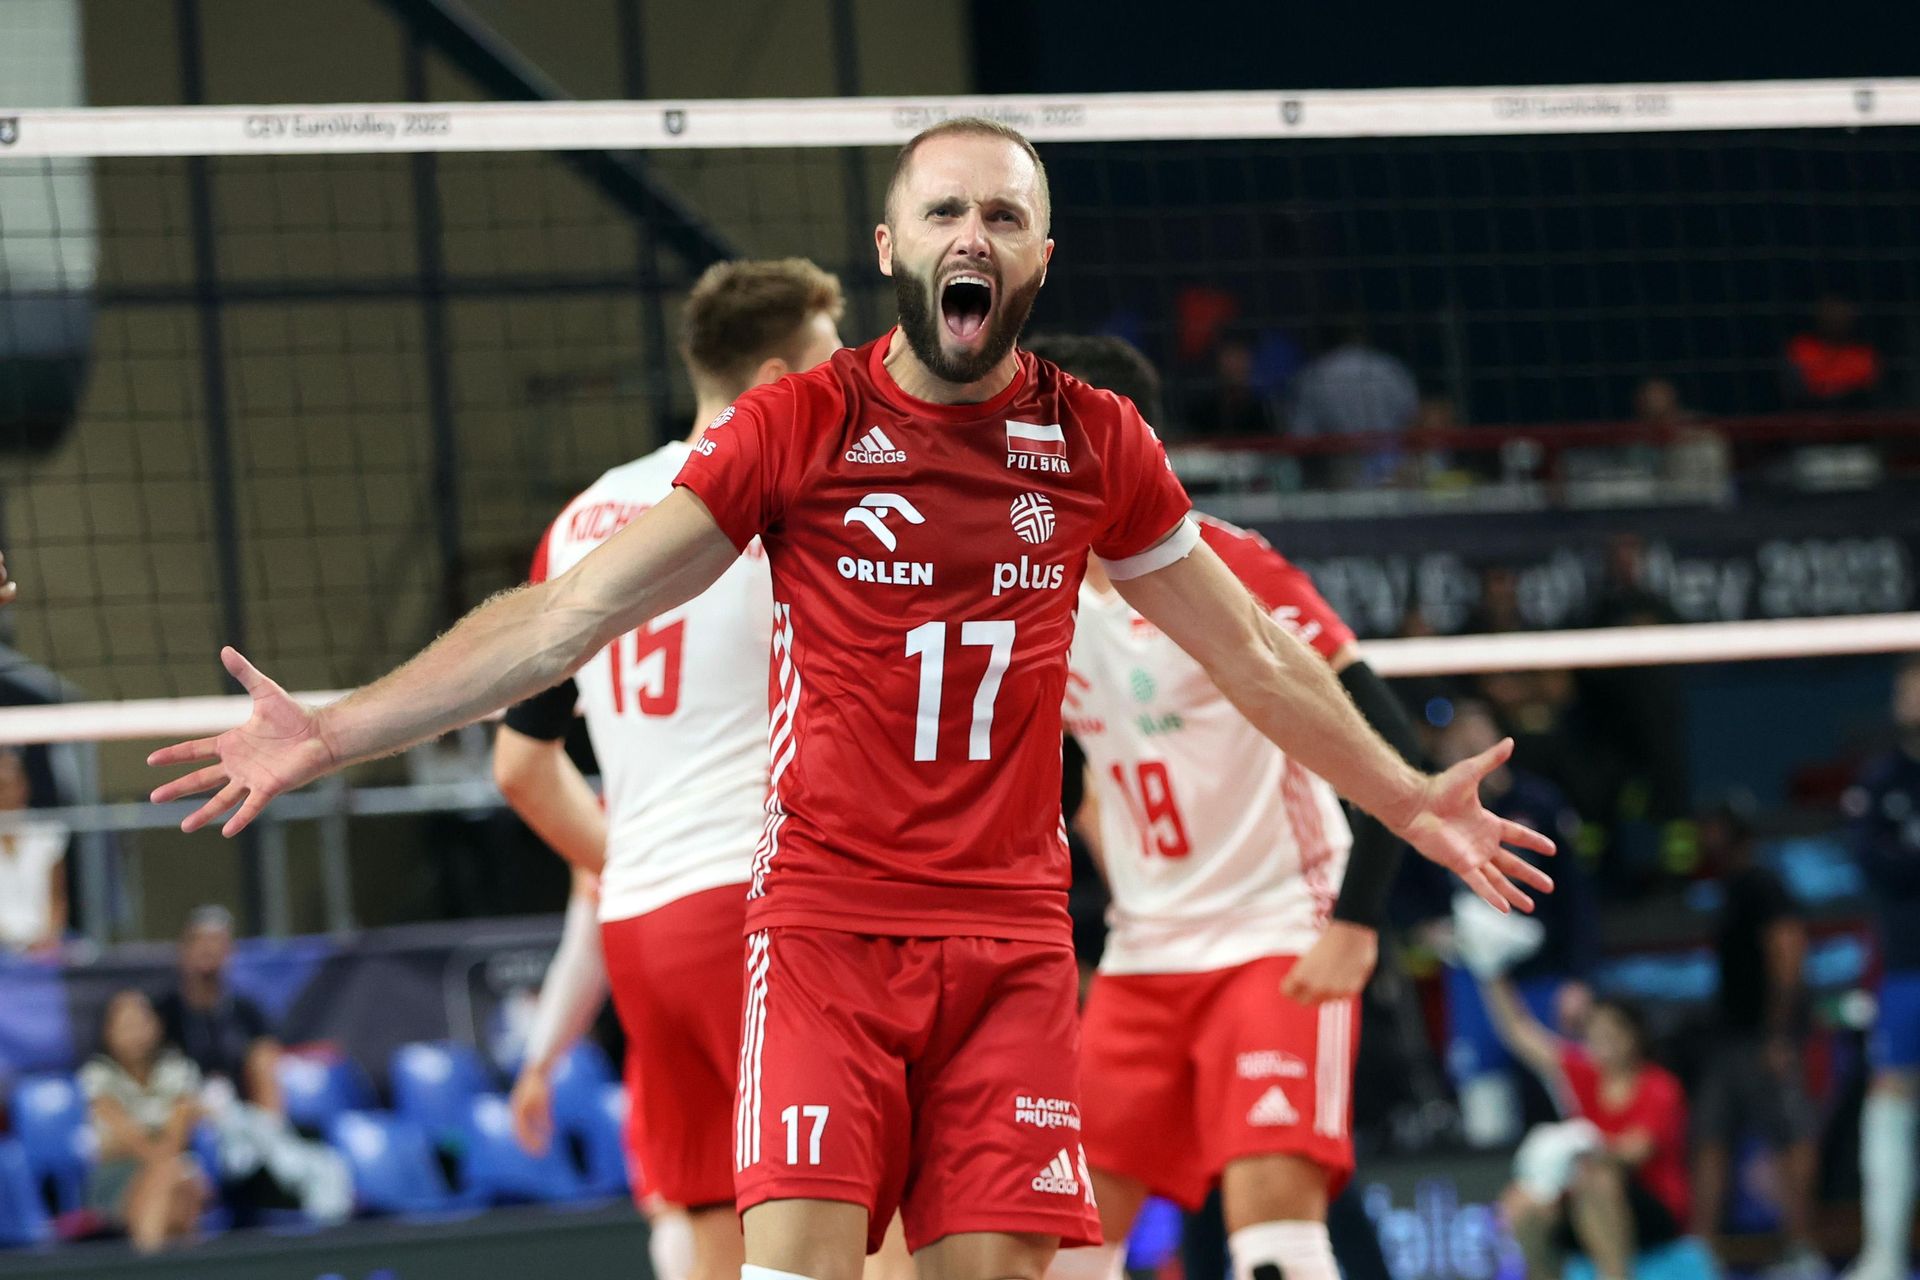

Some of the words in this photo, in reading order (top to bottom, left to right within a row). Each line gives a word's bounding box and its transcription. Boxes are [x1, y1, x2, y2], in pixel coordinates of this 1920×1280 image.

[845, 449, 907, 464] adidas
[1007, 454, 1070, 473] POLSKA
[837, 556, 934, 586] ORLEN
[992, 555, 1065, 596] plus
[609, 618, 687, 718] 15
[905, 620, 1016, 761] 17
[1110, 761, 1192, 861] 19
[1015, 1096, 1071, 1113] BLACHY
[781, 1105, 829, 1165] 17
